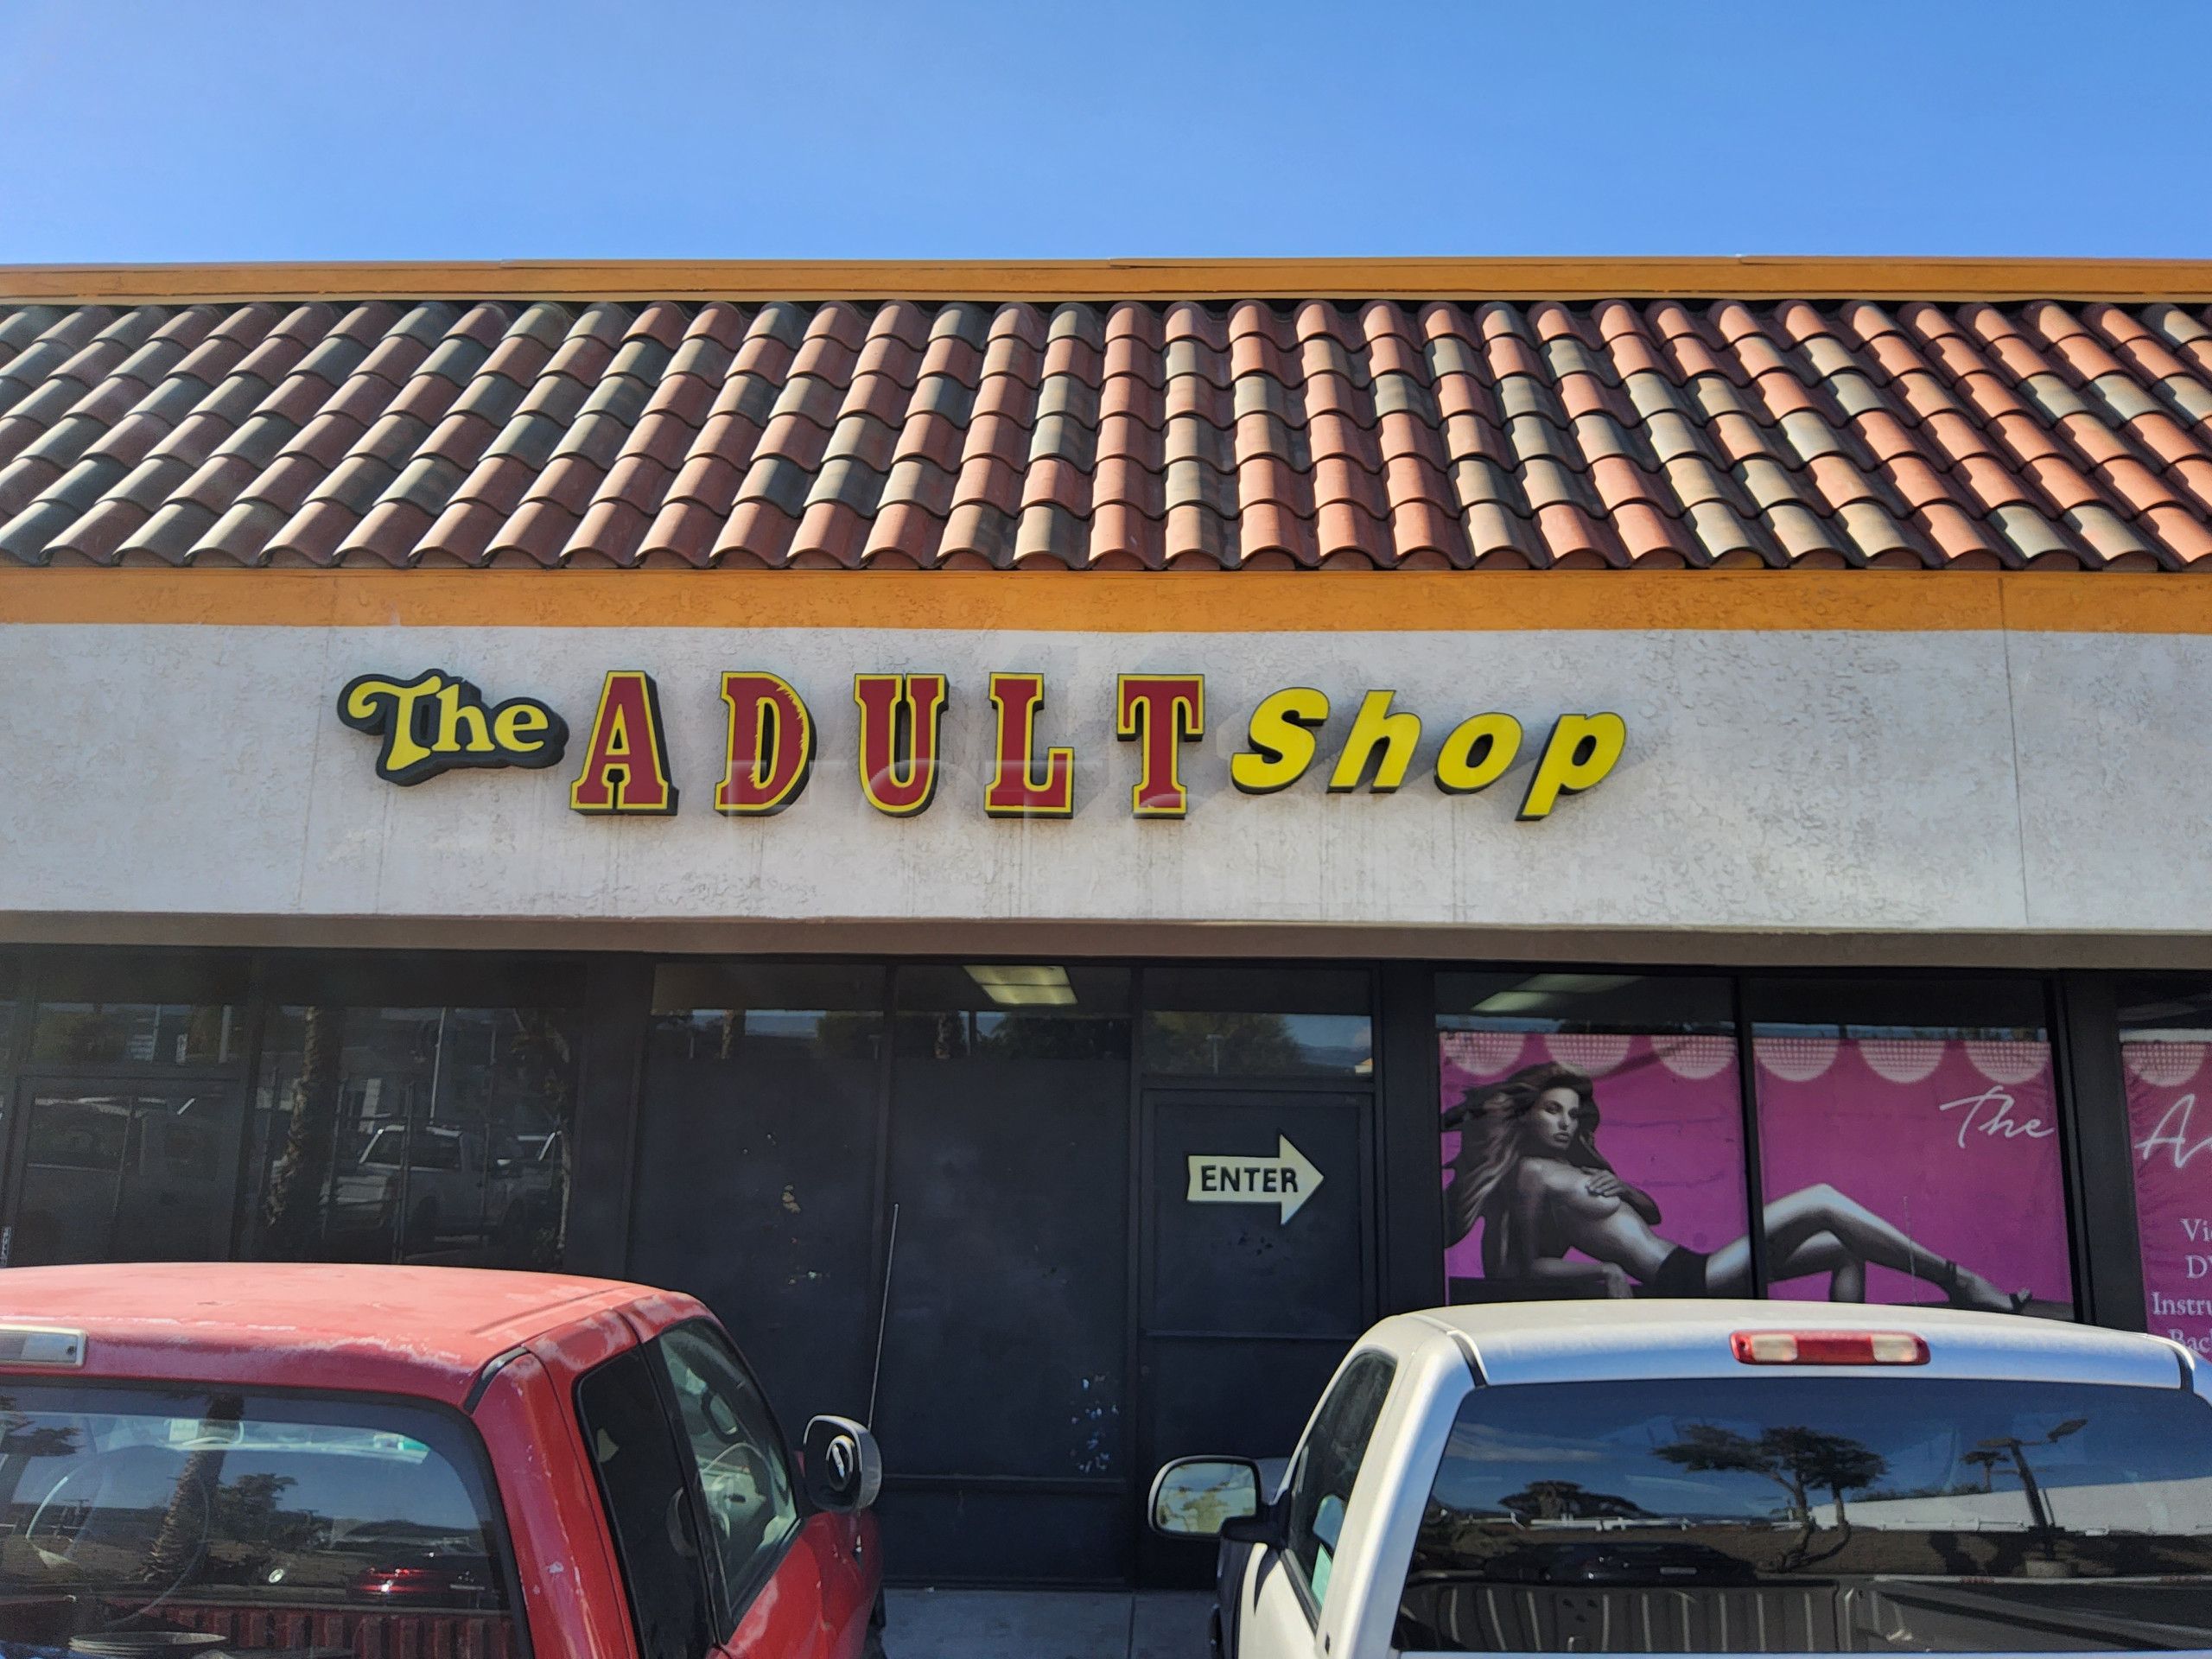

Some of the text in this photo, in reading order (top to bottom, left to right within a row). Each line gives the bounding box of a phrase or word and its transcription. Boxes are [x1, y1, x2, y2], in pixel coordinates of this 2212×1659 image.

[340, 670, 1627, 821] The ADULT Shop
[1939, 1084, 2212, 1168] The A
[1200, 1164, 1299, 1192] ENTER
[2179, 1217, 2212, 1242] Vi
[2185, 1255, 2212, 1279] D
[2167, 1328, 2212, 1353] Bac
